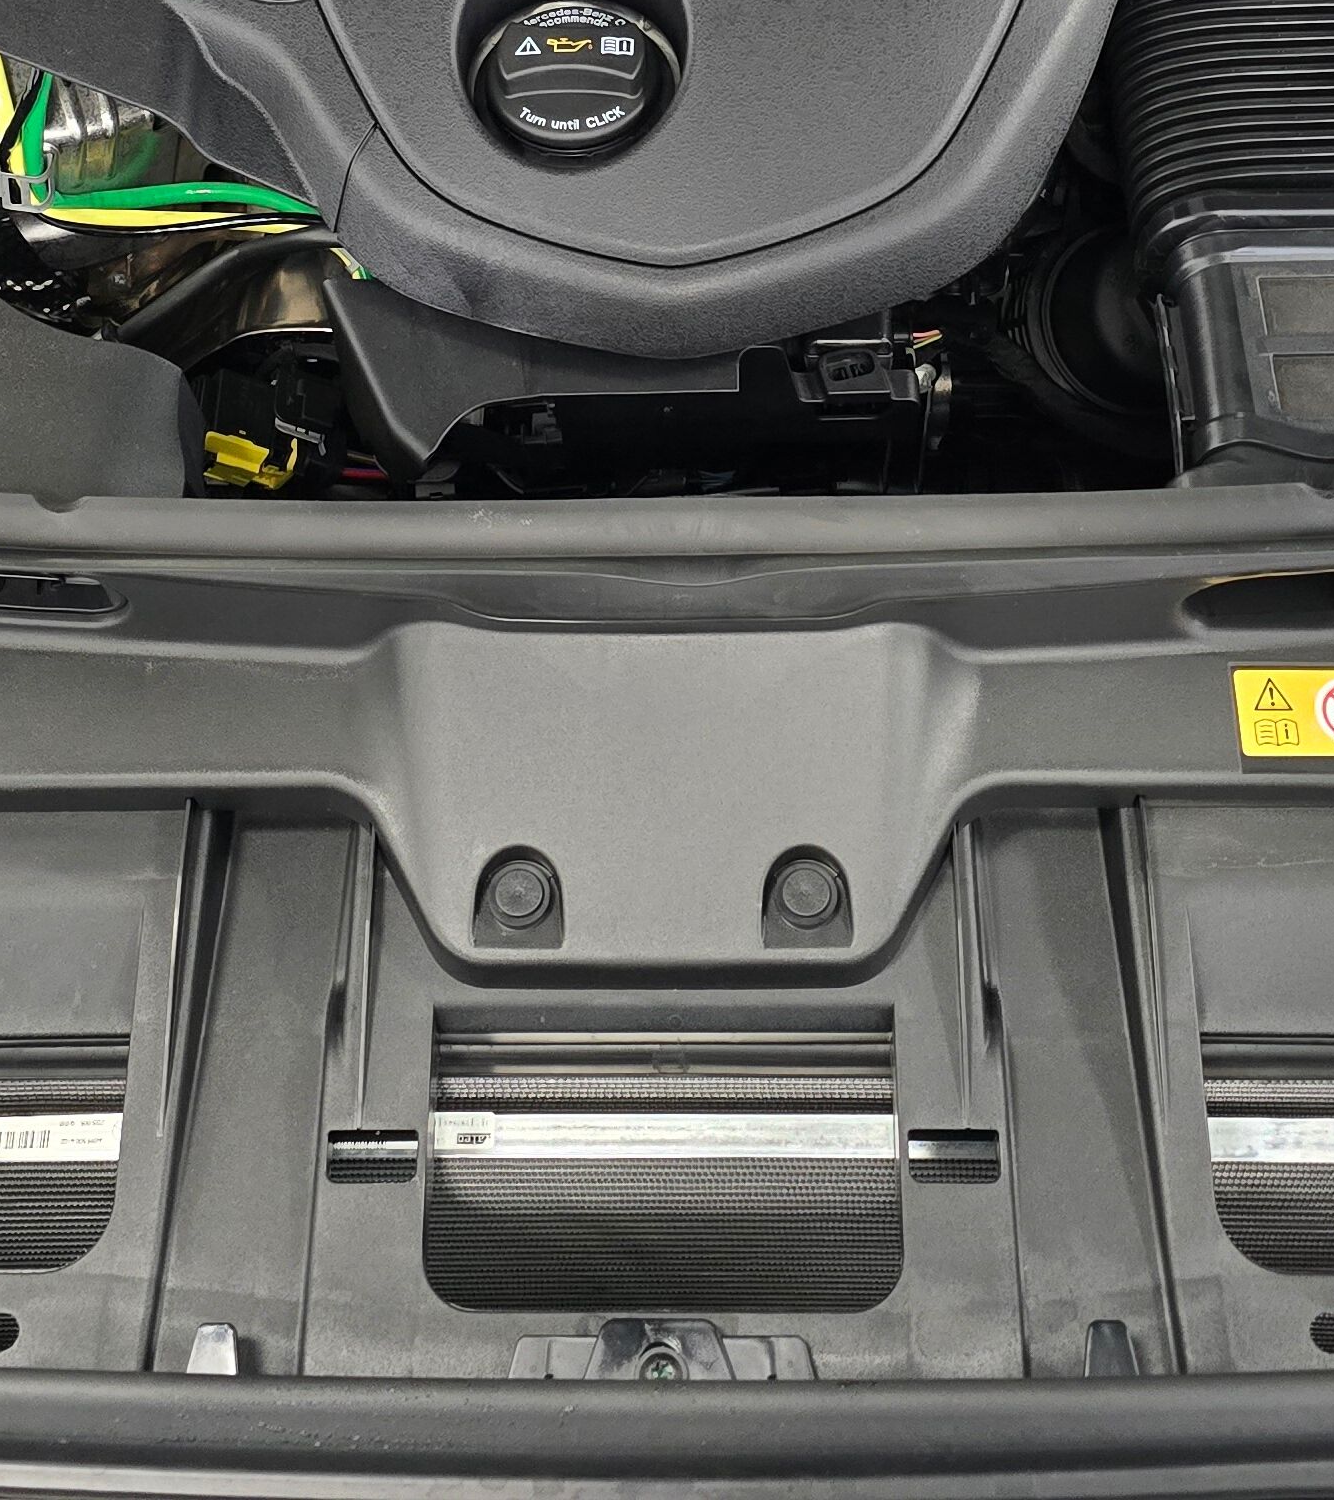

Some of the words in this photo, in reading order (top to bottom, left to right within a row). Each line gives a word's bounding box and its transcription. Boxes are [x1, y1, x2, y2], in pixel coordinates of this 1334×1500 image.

[519, 106, 547, 127] Turn
[551, 118, 580, 131] until
[585, 105, 626, 129] CLICK
